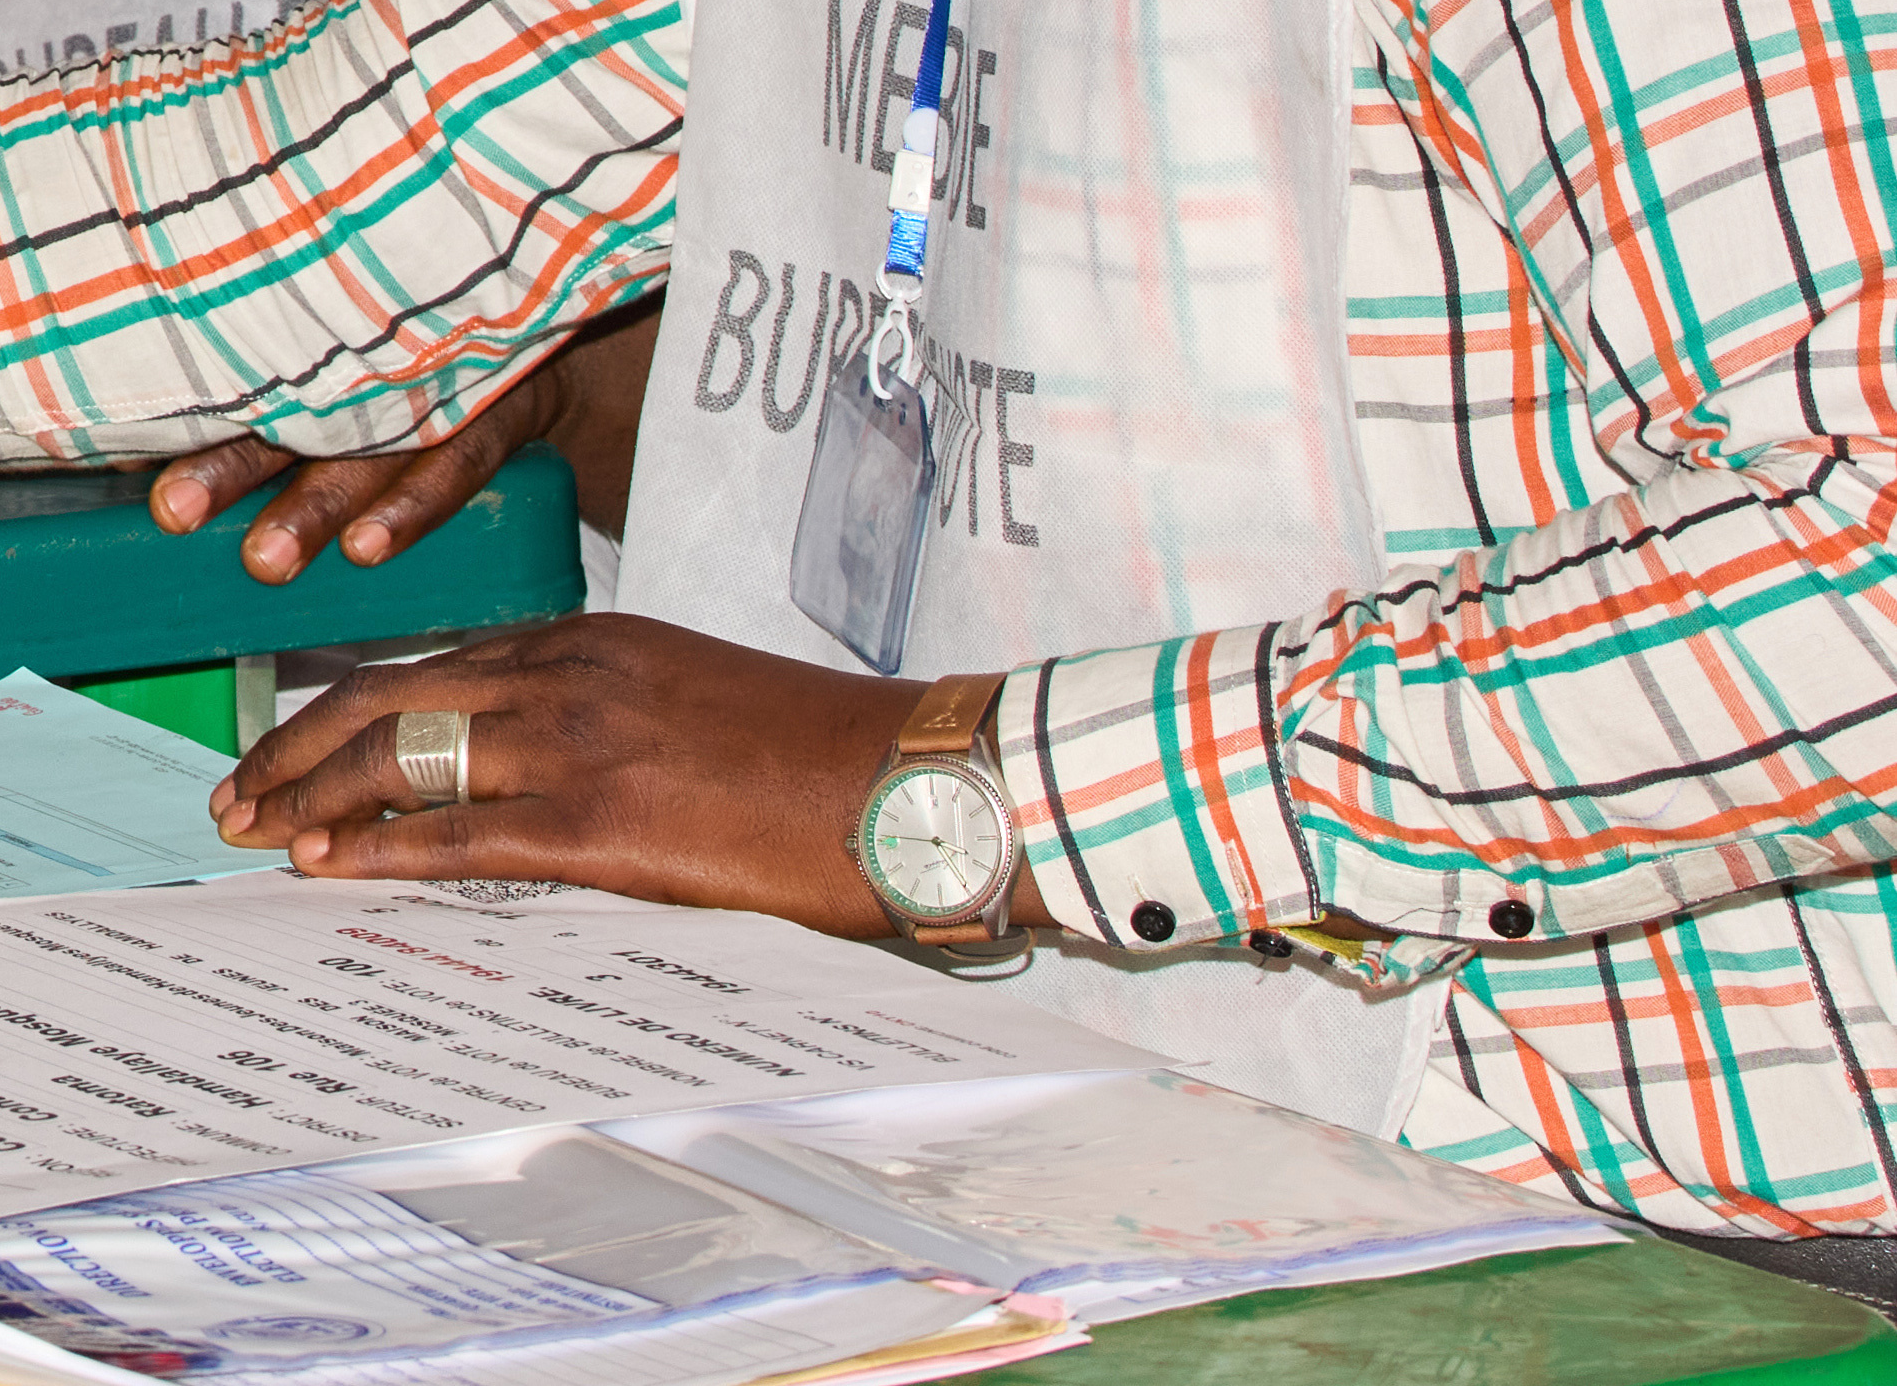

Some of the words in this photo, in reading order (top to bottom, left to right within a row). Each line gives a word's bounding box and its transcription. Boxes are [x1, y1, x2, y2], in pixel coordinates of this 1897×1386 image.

[317, 957, 385, 977] 100
[610, 950, 750, 993] 1944301
[617, 1017, 672, 1032] DE
[216, 1050, 286, 1071] 106
[665, 1033, 804, 1076] NUMÉRO
[89, 1046, 272, 1108] Hamdallaye
[288, 1071, 357, 1093] Rue
[50, 1075, 175, 1117] Ratoma
